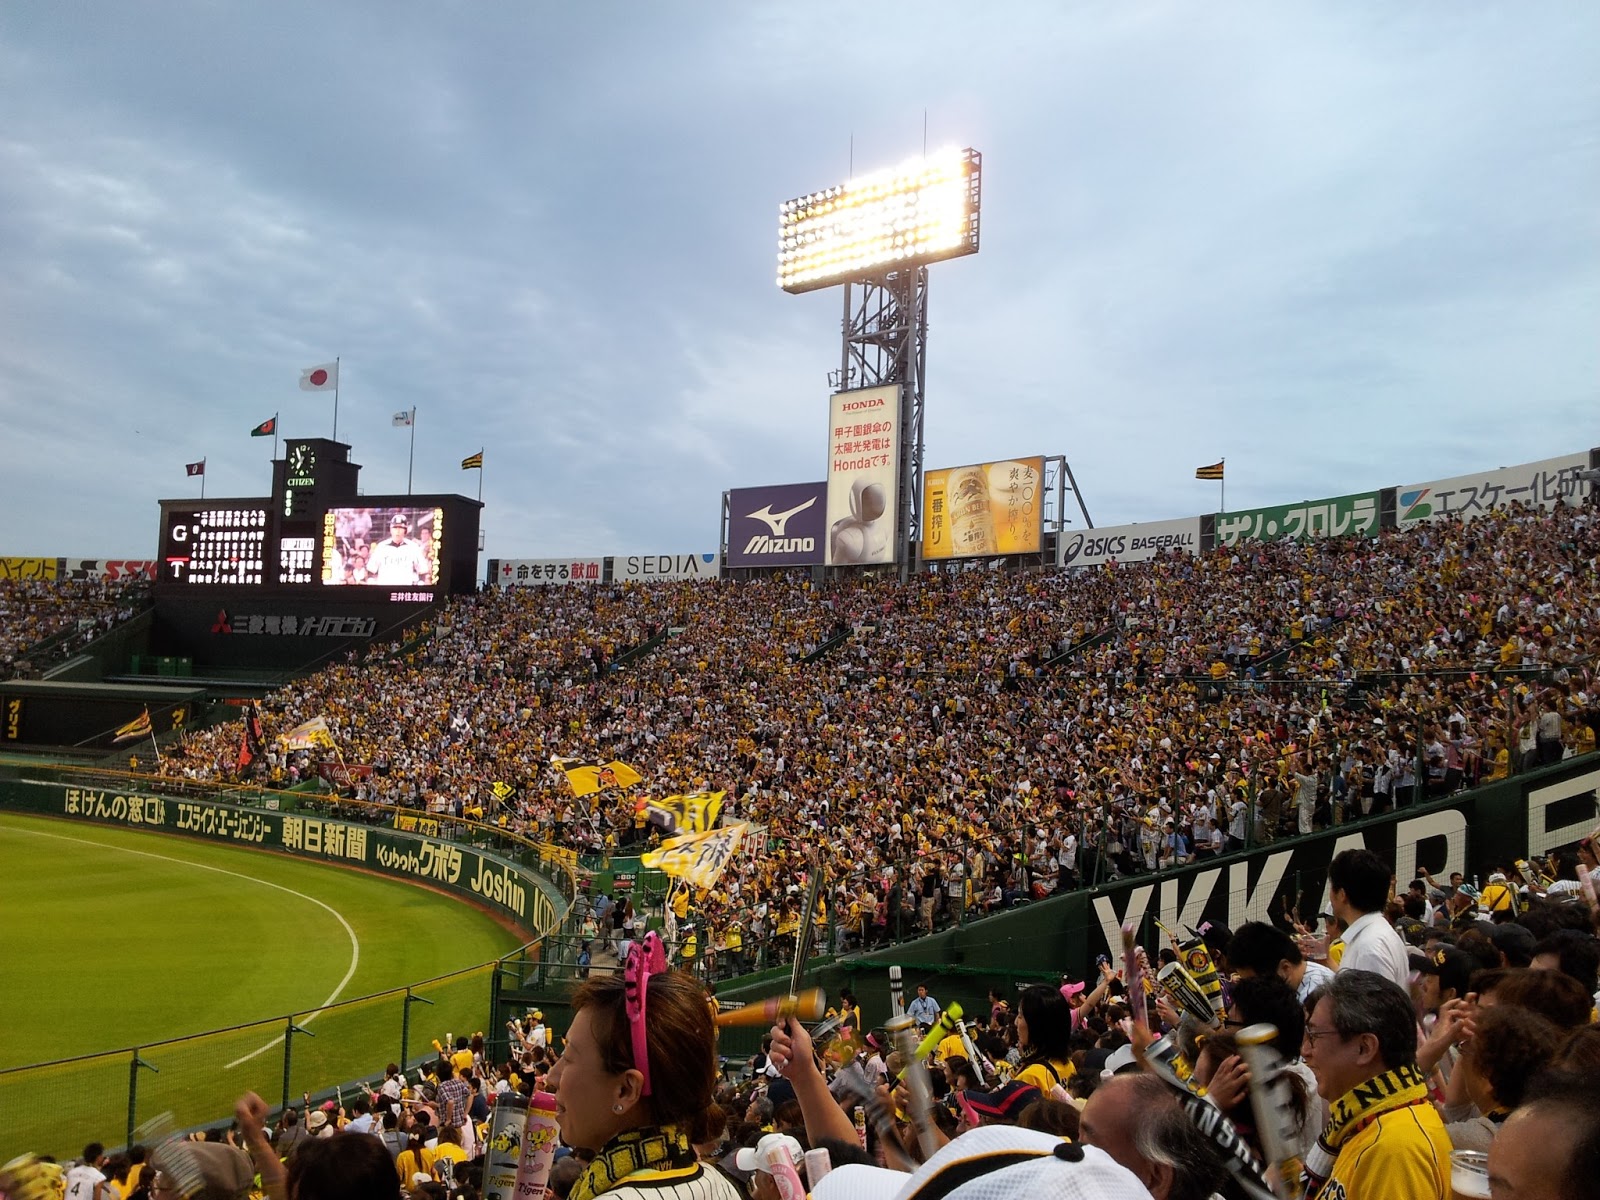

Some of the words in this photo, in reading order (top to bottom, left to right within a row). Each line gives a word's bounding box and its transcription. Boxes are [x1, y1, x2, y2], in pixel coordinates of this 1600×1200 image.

[842, 398, 885, 411] HONDA
[834, 421, 892, 439] 甲子園銀傘の
[834, 438, 891, 455] 太陽光発電は
[833, 454, 891, 472] Hondaです。
[287, 478, 315, 486] CITIZEN
[1434, 464, 1585, 517] エスケー化研
[932, 490, 943, 545] 一番搾り
[1217, 498, 1376, 548] サン・クロレラ
[173, 525, 187, 541] G
[1131, 533, 1194, 550] BASEBALL
[171, 561, 184, 578] T
[517, 562, 600, 580] 命を守る献血
[627, 554, 699, 574] SEDIA
[233, 615, 298, 635] 三菱電機
[8, 699, 20, 739] グリコ
[282, 816, 368, 862] 朝日新聞
[419, 839, 463, 884] クボタ
[470, 855, 526, 918] Joshin
[1092, 849, 1296, 962] YKK
[71, 1182, 81, 1196] 4
[518, 1181, 545, 1196] Tigers
